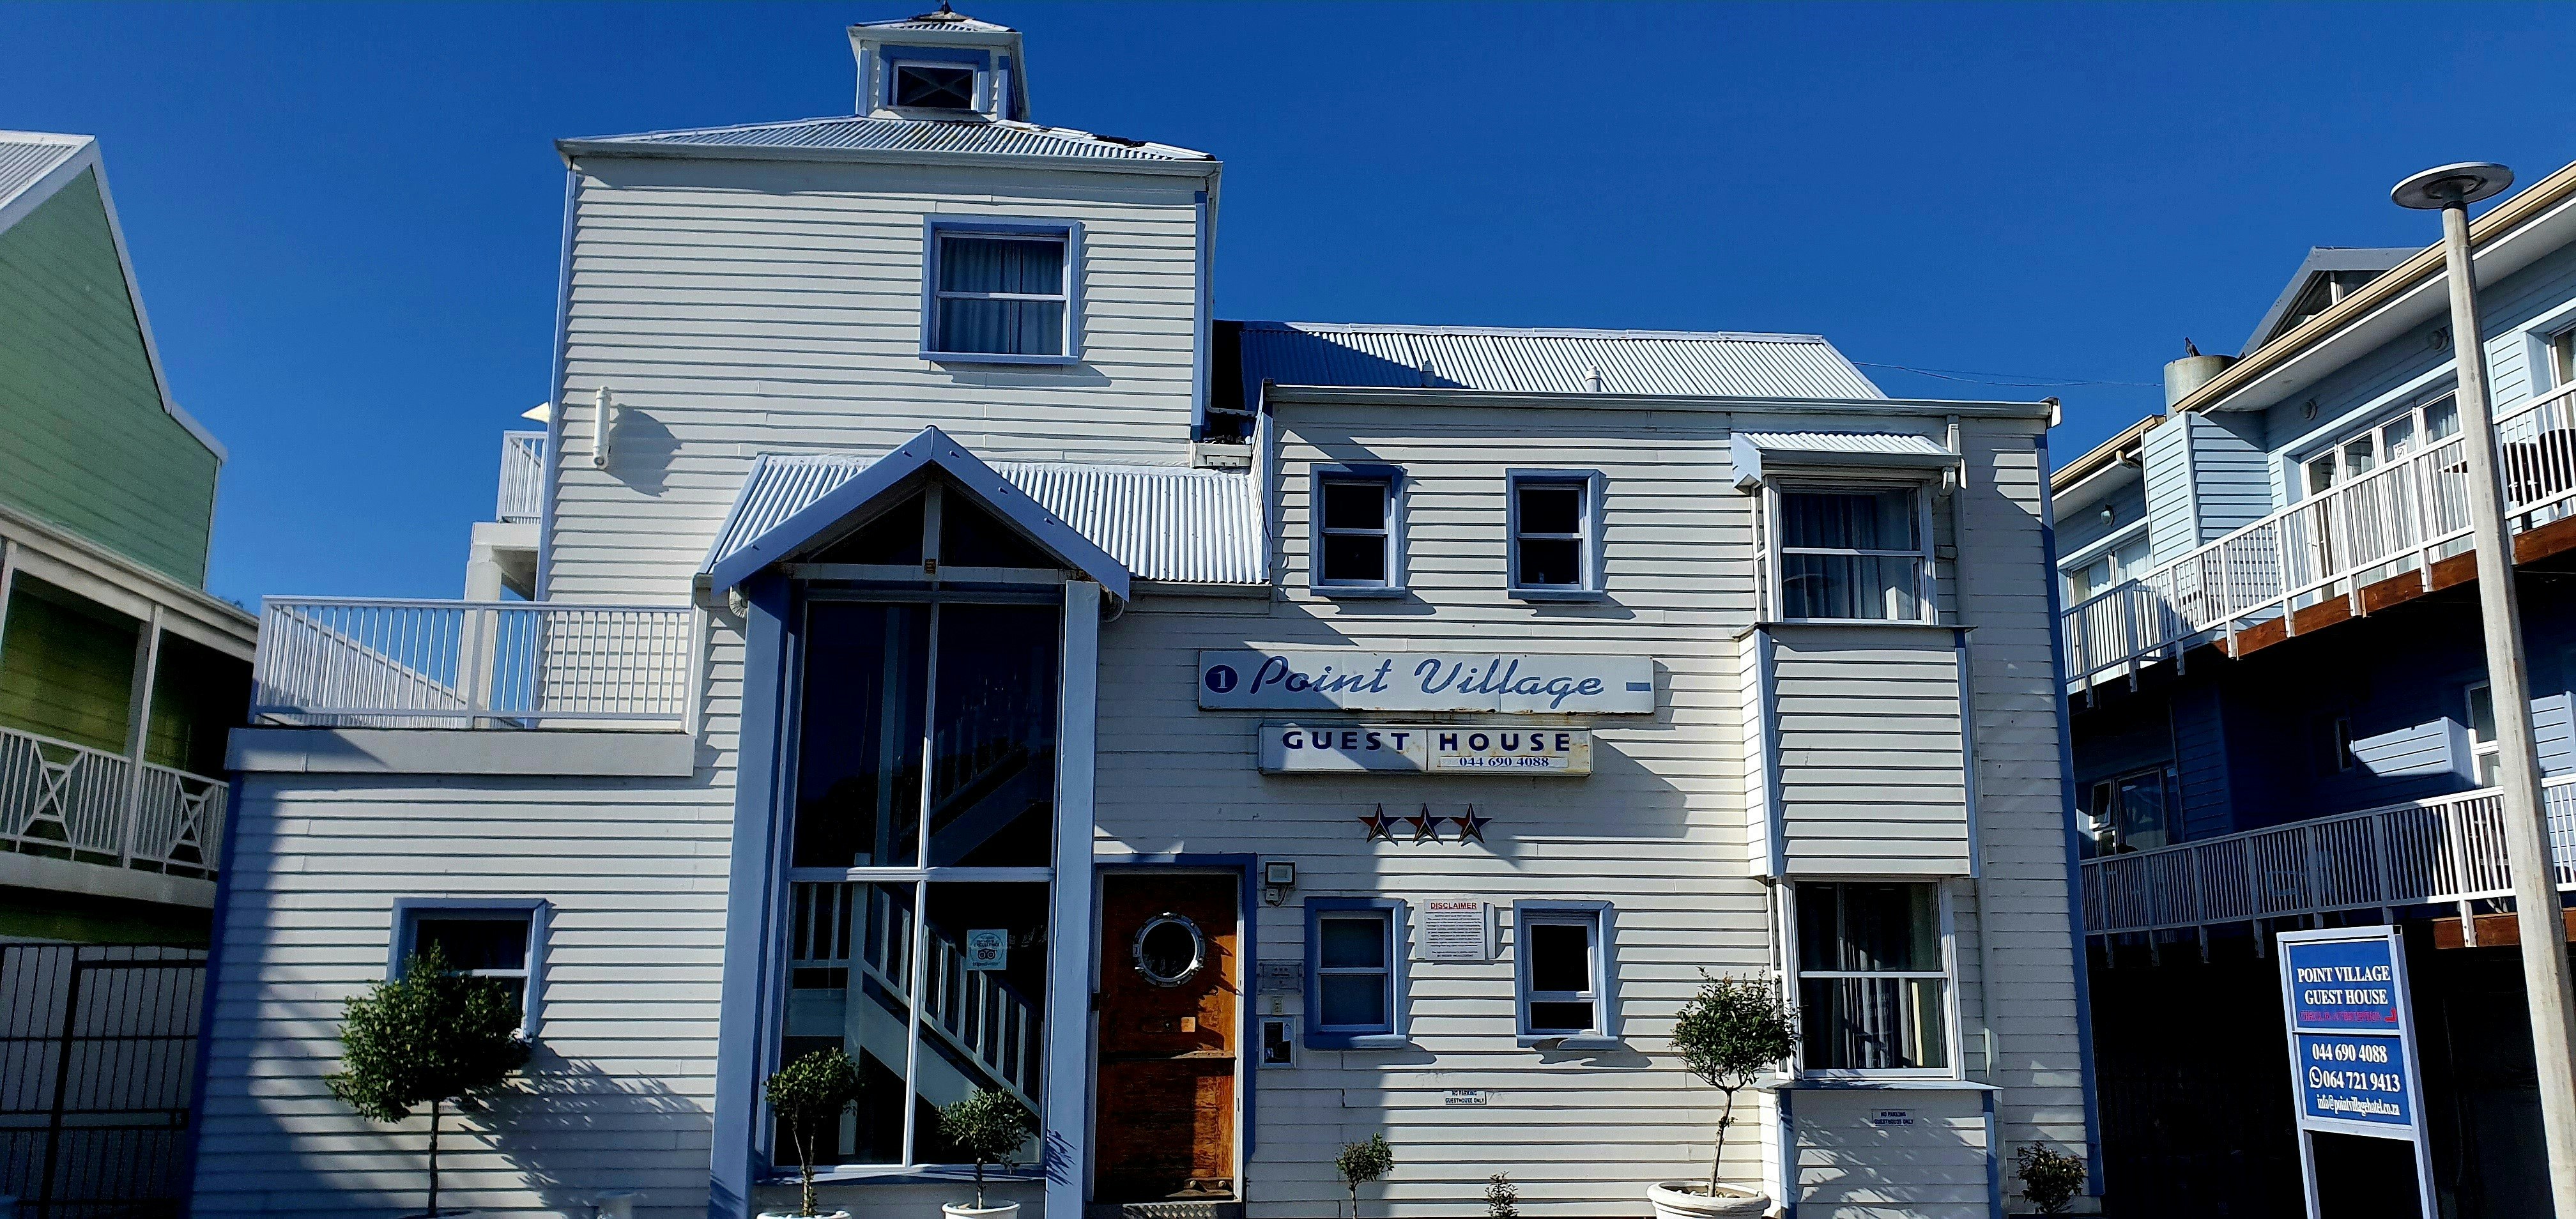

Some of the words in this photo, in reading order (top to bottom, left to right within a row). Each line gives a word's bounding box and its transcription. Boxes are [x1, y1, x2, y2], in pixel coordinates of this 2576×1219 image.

[1250, 656, 1392, 694] Point
[1414, 658, 1604, 709] Village
[1282, 730, 1411, 751] GUEST
[1439, 732, 1571, 752] HOUSE
[1459, 756, 1487, 767] 044
[1488, 756, 1514, 767] 690
[1515, 756, 1549, 767] 4088
[2297, 967, 2333, 983] POINT
[2334, 965, 2391, 982] VILLAGE
[2304, 990, 2343, 1005] GUEST
[2345, 989, 2388, 1004] HOUSE
[2312, 1043, 2333, 1061] 044
[2334, 1043, 2356, 1061] 690
[2358, 1044, 2388, 1063] 4088
[2323, 1070, 2345, 1089] 064
[2345, 1071, 2368, 1091] 721
[2370, 1073, 2400, 1092] 9413
[2317, 1093, 2400, 1116] info@pointvillagehotel.co.za
